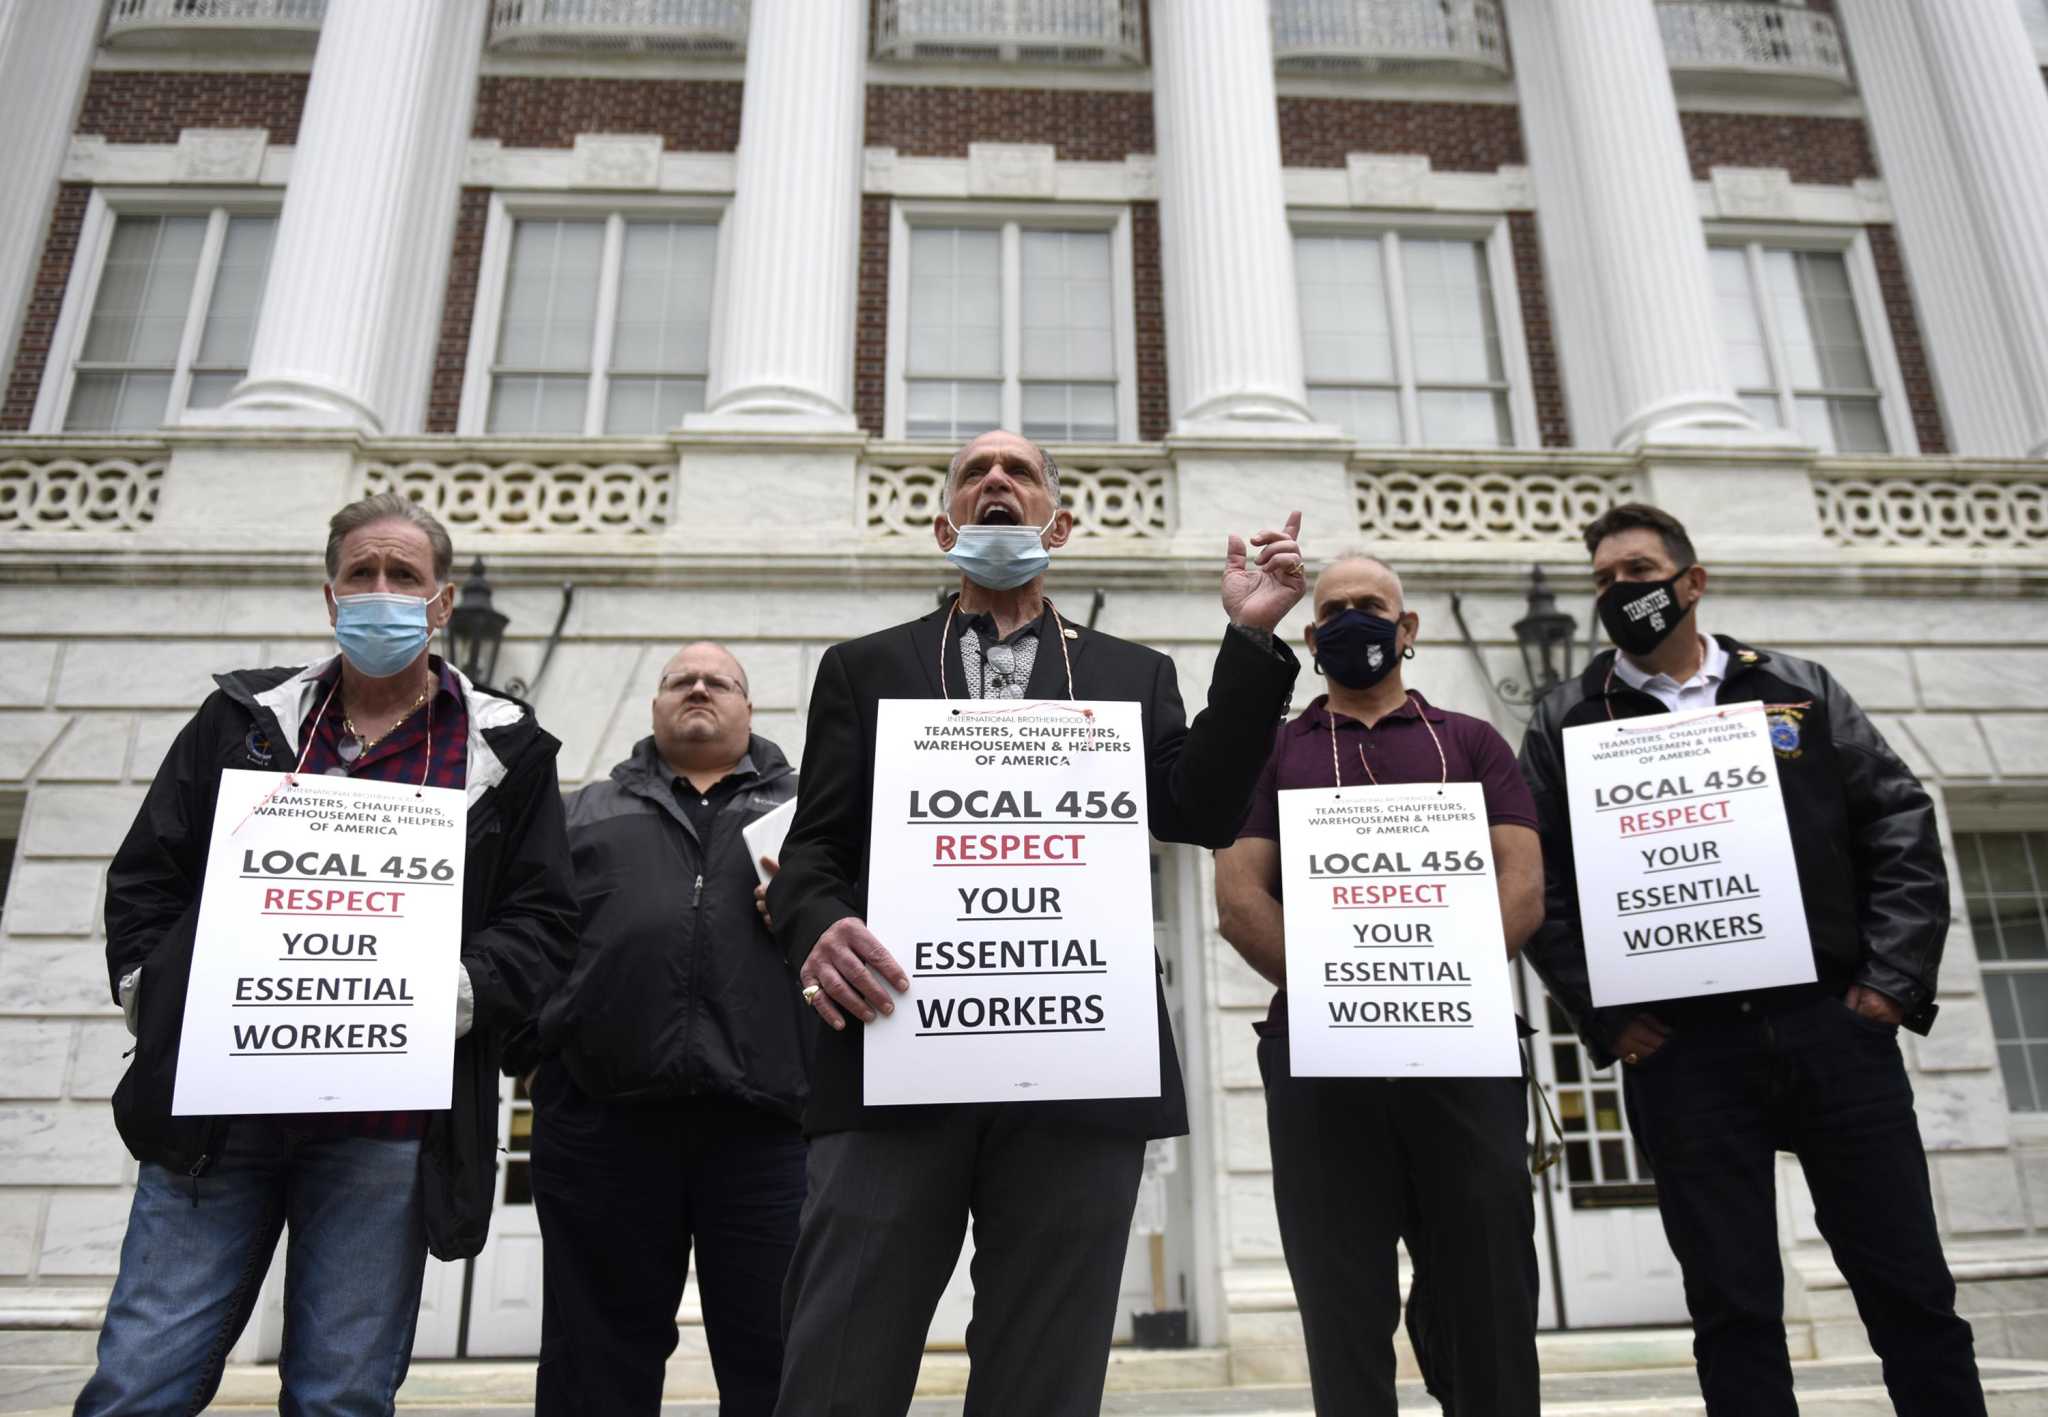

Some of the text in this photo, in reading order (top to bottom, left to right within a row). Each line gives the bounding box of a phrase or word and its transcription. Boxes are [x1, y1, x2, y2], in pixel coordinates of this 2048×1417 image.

[924, 726, 1120, 740] TEAMSTERS, CHAUFFEURS,
[948, 716, 1014, 724] INTERNATIONAL
[1017, 716, 1083, 725] BROTHERHOOD
[914, 740, 1131, 753] WAREHOUSEMEN & HELPERS
[1592, 730, 1757, 761] WAREHOUSEMEN & HELPERS
[1639, 747, 1711, 765] OF AMERICA
[975, 755, 1071, 766] OF AMERICA
[1595, 764, 1767, 808] LOCAL 456
[253, 805, 455, 829] WAREHOUSEMEN & HELPERS
[353, 801, 446, 817] CHAUFFEURS,
[909, 789, 1138, 820] LOCAL 456
[1619, 799, 1731, 835] RESPECT
[309, 821, 399, 836] OF AMERICA
[1308, 812, 1477, 826] WAREHOUSEMEN & HELPERS
[1356, 825, 1431, 835] OF AMERICA
[935, 834, 1086, 861] RESPECT
[1641, 839, 1720, 869] YOUR
[242, 848, 456, 882] LOCAL 456
[1309, 850, 1485, 875] LOCAL 456
[263, 887, 406, 914] RESPECT
[957, 886, 1062, 915] YOUR
[1332, 884, 1447, 905] RESPECT
[1616, 872, 1760, 912] ESSENTIAL
[281, 932, 378, 956] YOUR
[1353, 923, 1433, 943] YOUR
[1623, 913, 1764, 951] WORKERS
[914, 938, 1107, 971] ESSENTIAL
[1324, 961, 1471, 982] ESSENTIAL
[234, 977, 414, 1002] ESSENTIAL
[916, 994, 1105, 1029] WORKERS
[1328, 1001, 1473, 1023] WORKERS
[232, 1022, 408, 1050] WORKERS
